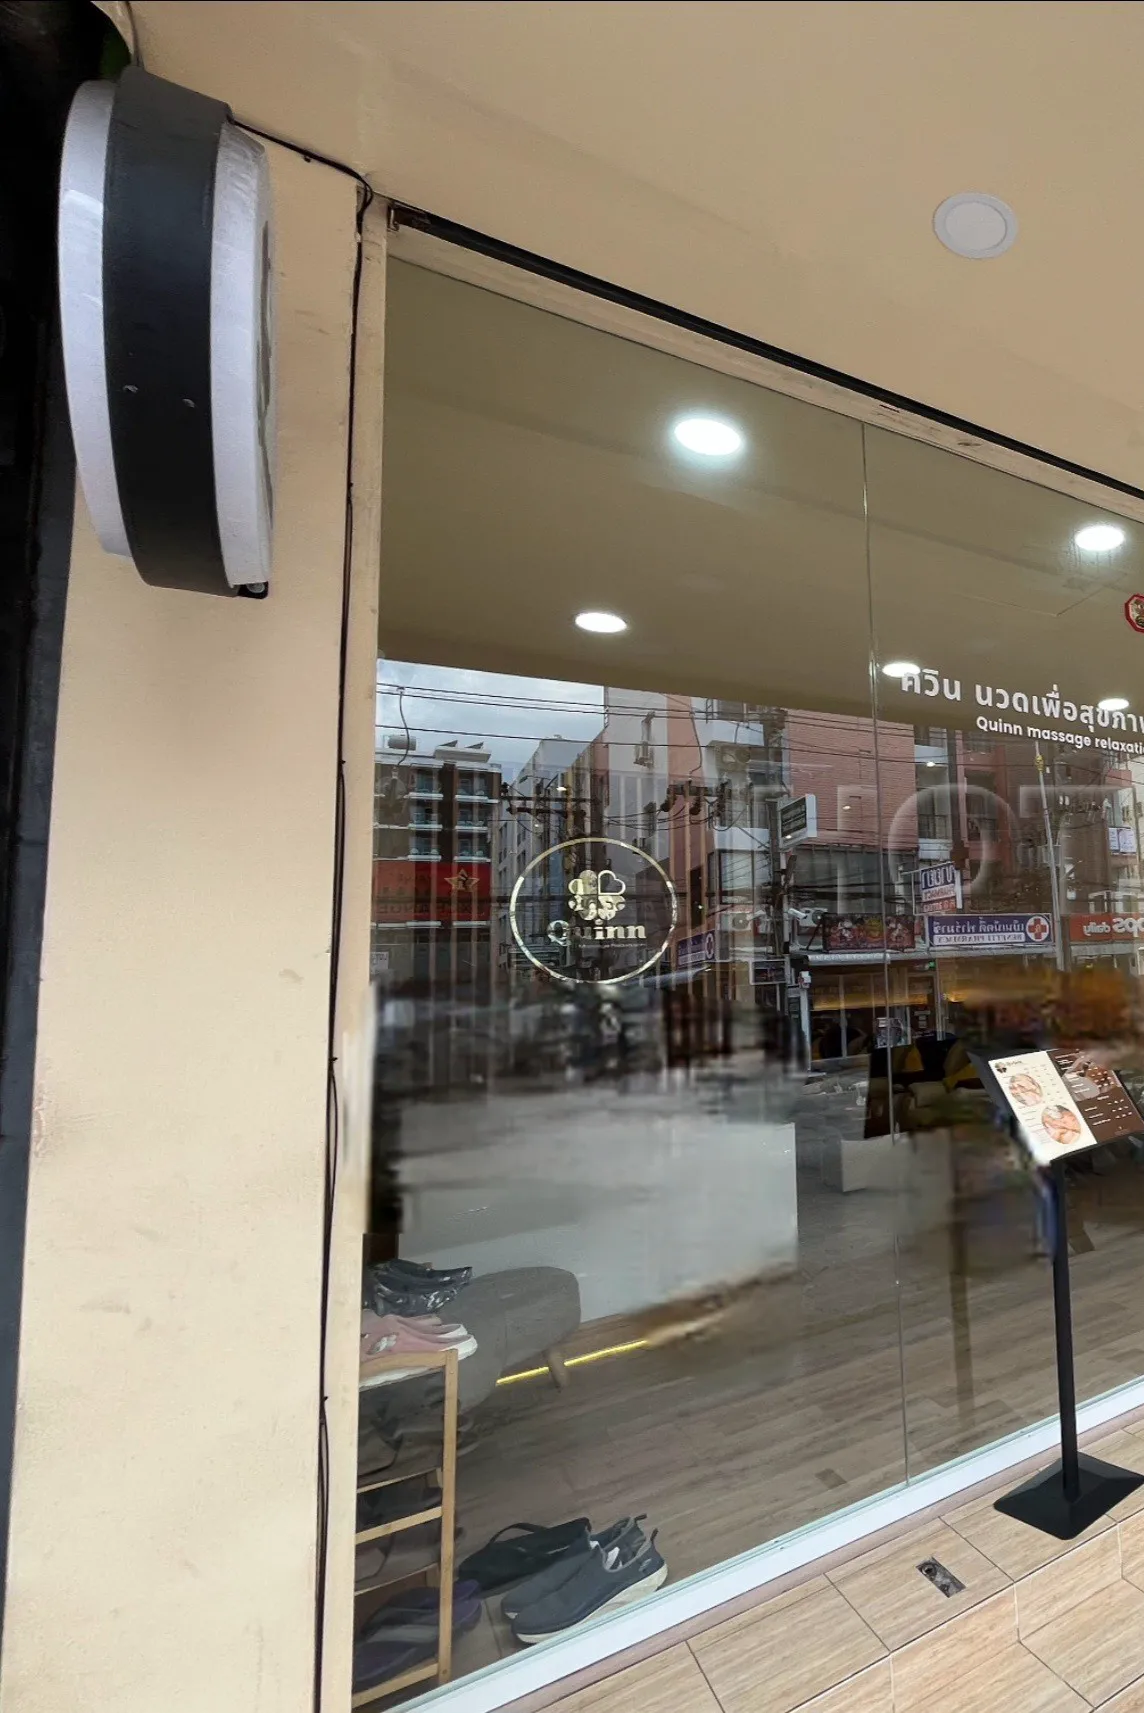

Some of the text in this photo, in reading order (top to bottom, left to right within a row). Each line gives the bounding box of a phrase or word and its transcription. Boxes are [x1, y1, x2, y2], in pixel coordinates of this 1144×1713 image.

[976, 715, 1023, 736] Quinn
[1027, 726, 1091, 749] massage
[546, 918, 647, 947] Quinn
